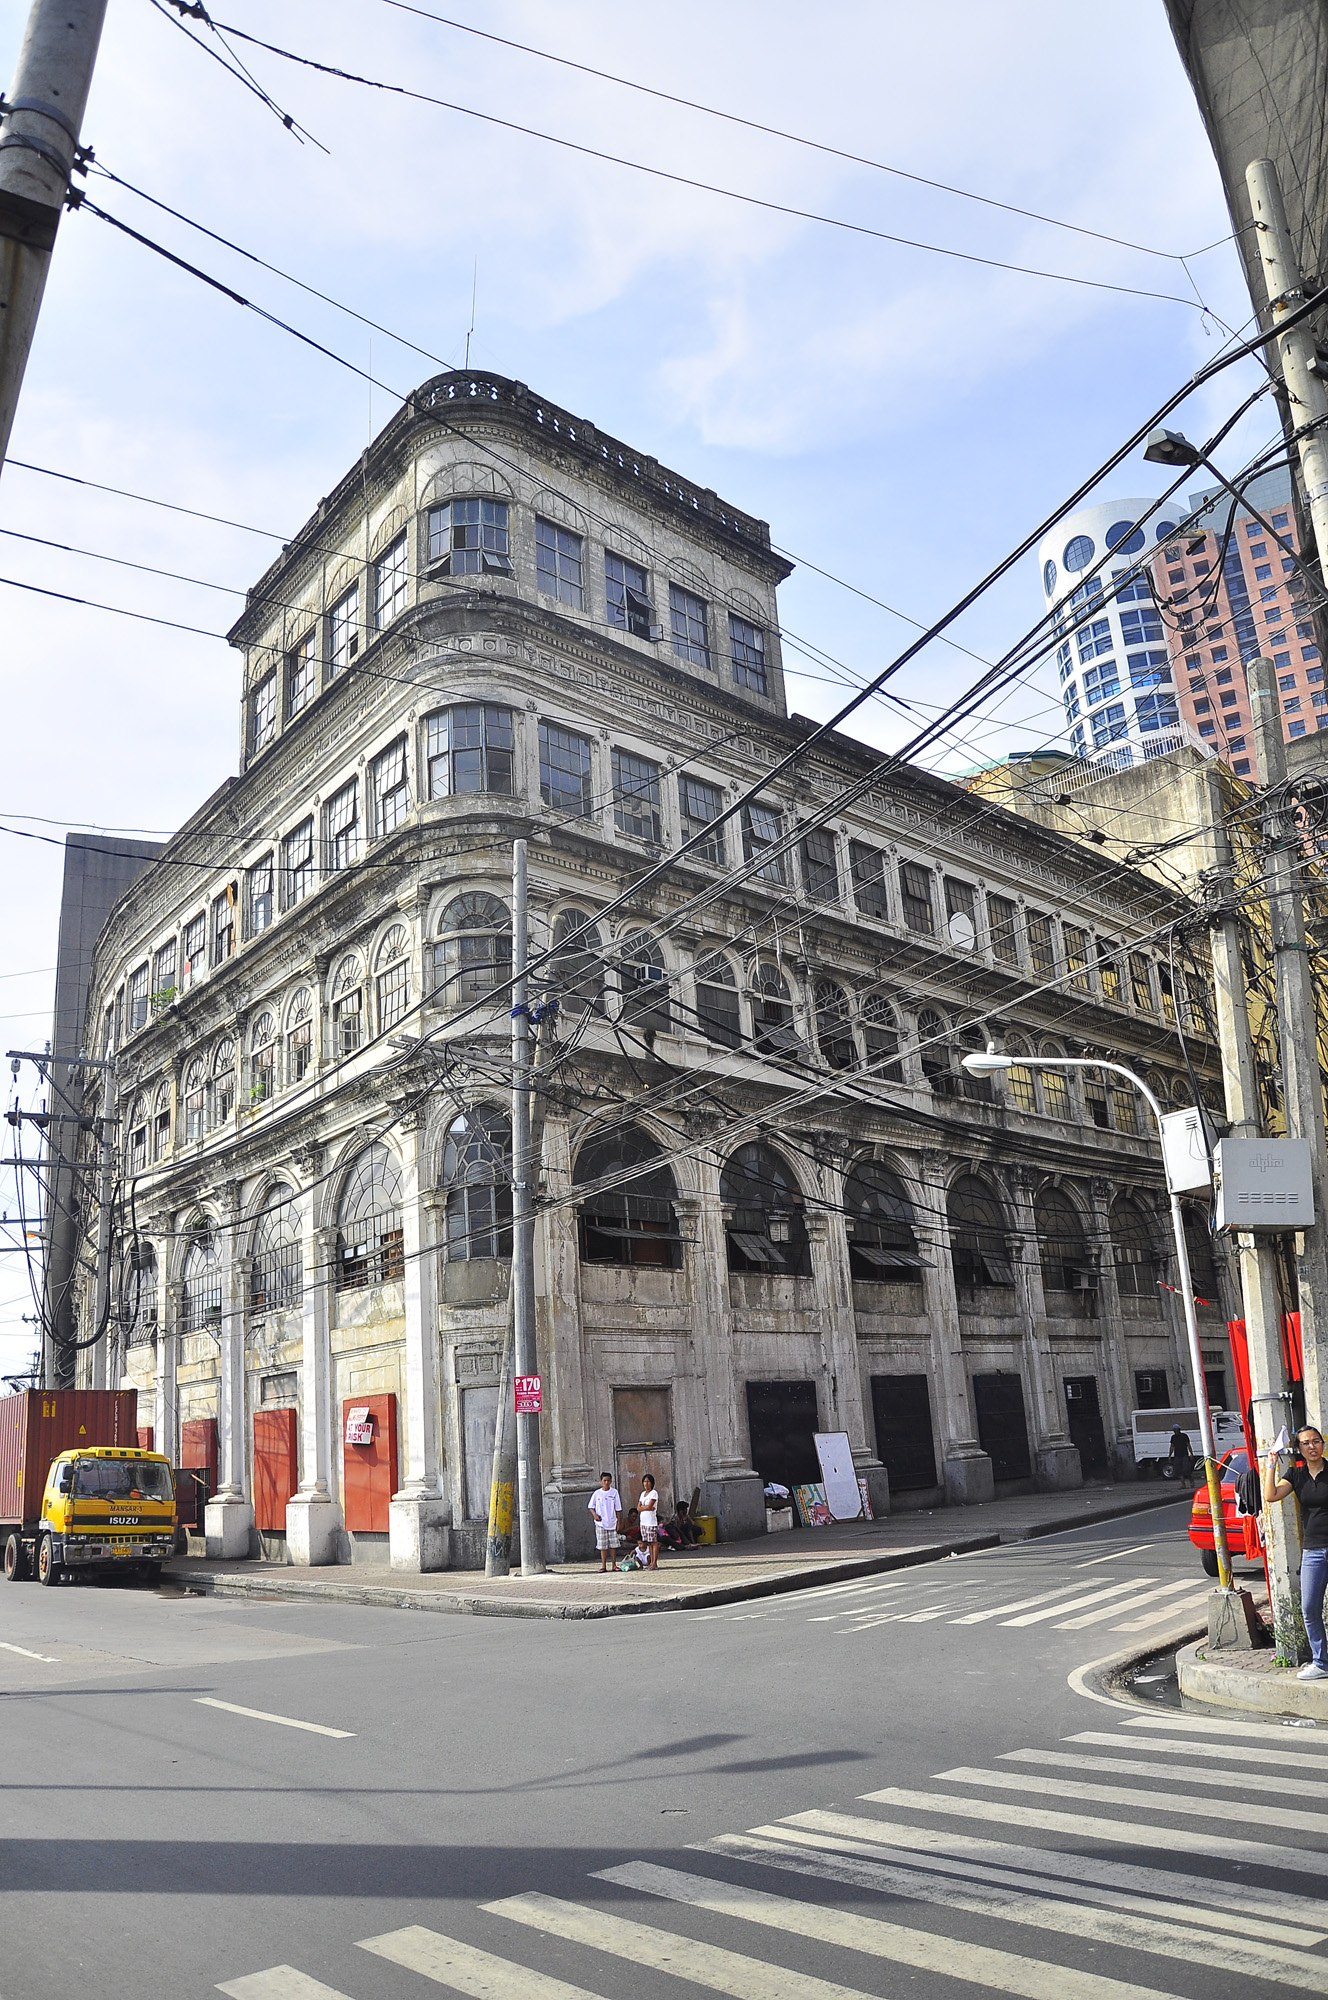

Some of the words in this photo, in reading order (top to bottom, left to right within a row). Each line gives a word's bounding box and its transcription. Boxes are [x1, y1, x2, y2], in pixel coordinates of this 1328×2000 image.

[348, 1423, 353, 1432] AT
[354, 1424, 371, 1434] YOUR
[347, 1432, 363, 1442] RISK
[109, 1516, 139, 1525] ISUZU
